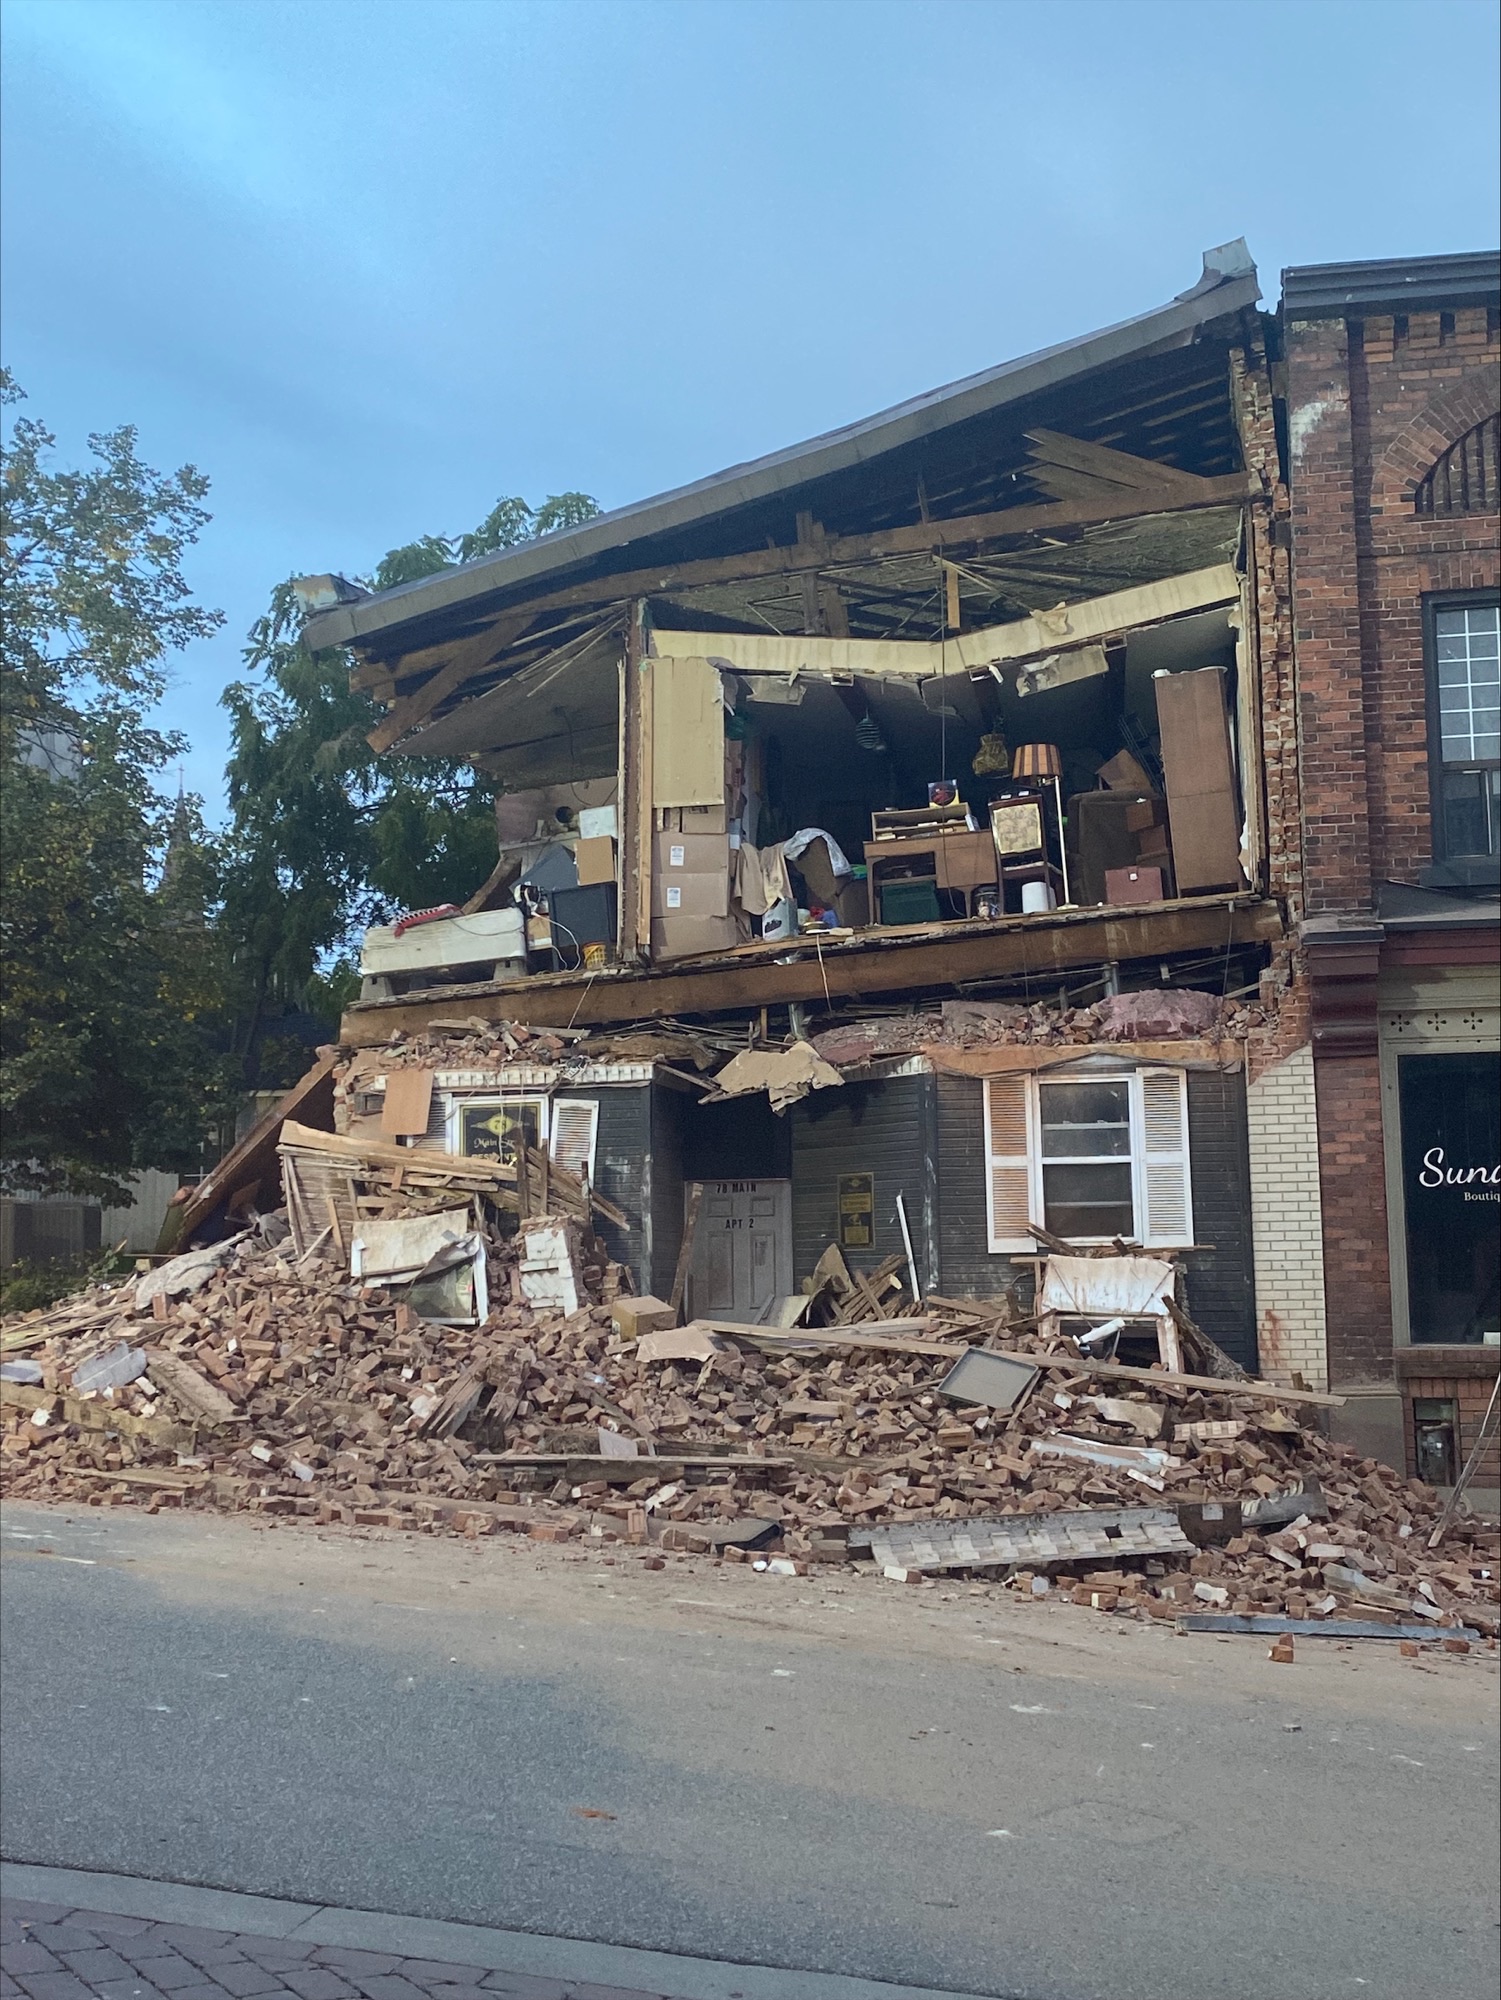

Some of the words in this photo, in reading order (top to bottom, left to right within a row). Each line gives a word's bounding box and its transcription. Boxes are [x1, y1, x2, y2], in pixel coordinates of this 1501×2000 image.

[473, 1138, 497, 1148] Main
[717, 1184, 727, 1193] 78
[732, 1183, 756, 1192] MAIN
[1463, 1191, 1500, 1203] Boutiq
[725, 1219, 743, 1229] APT
[749, 1218, 754, 1228] 2
